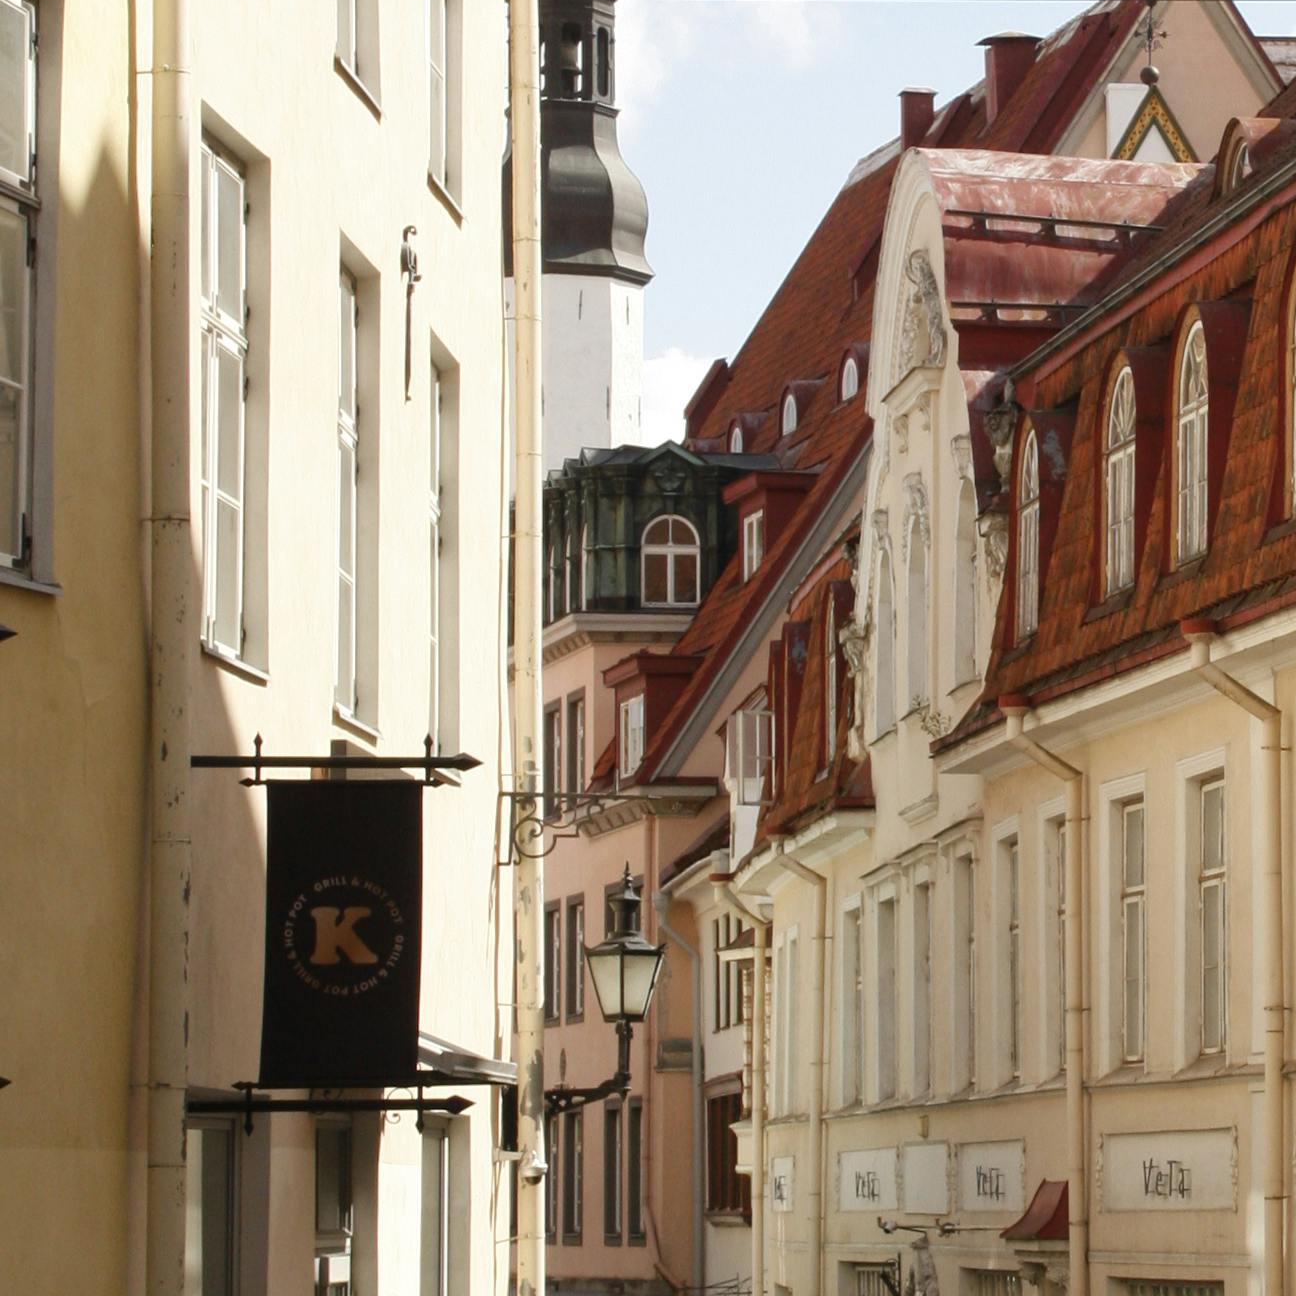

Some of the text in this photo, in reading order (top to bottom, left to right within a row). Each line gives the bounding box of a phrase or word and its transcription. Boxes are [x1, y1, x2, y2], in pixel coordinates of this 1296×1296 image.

[314, 875, 347, 892] GRILL
[288, 894, 308, 918] POT
[284, 920, 295, 947] HOT
[309, 906, 379, 965] K
[385, 934, 404, 967] GRILL
[323, 985, 350, 995] POT
[353, 976, 379, 995] HOT
[1143, 1157, 1188, 1199] VeTa
